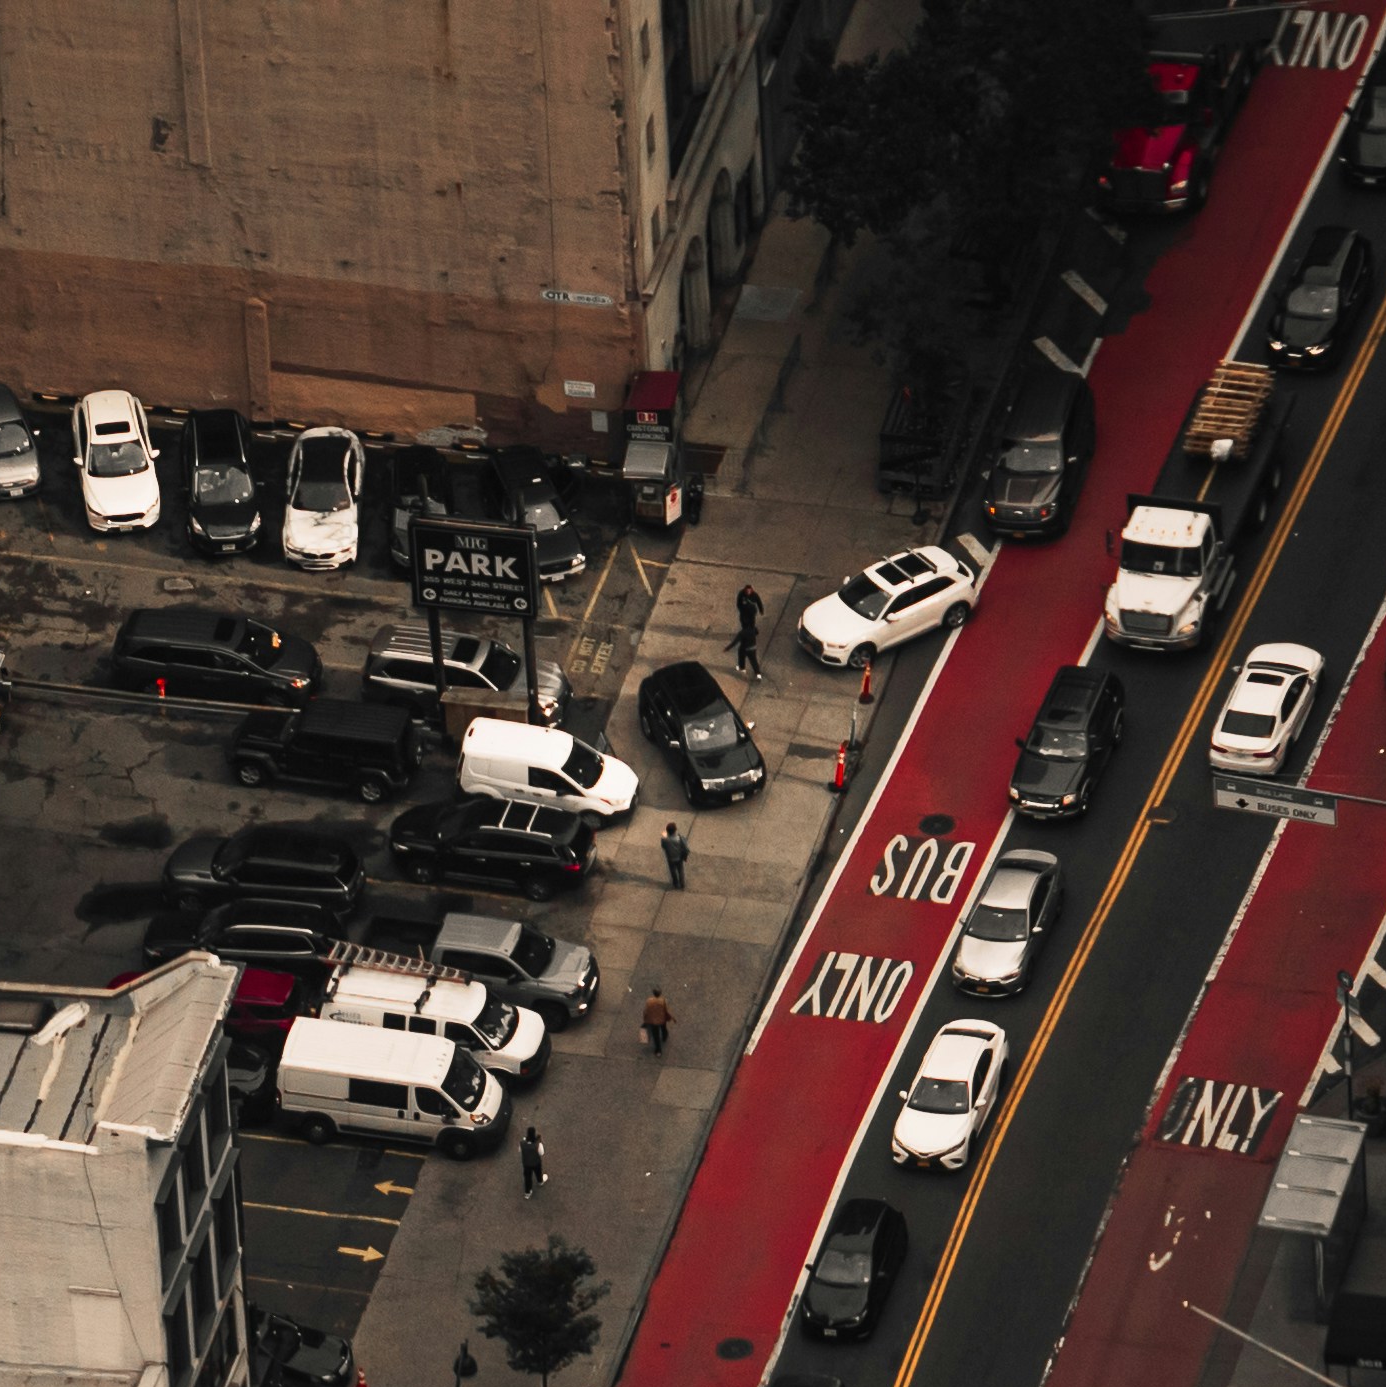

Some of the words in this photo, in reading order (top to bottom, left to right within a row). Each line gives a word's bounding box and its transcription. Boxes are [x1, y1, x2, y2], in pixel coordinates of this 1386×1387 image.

[424, 548, 520, 580] PARK
[443, 577, 467, 587] WEST
[492, 581, 526, 592] STREET
[1257, 802, 1290, 816] BUSES
[1292, 808, 1318, 820] ONLY
[870, 834, 976, 905] BUS
[789, 951, 914, 1024] ONLY
